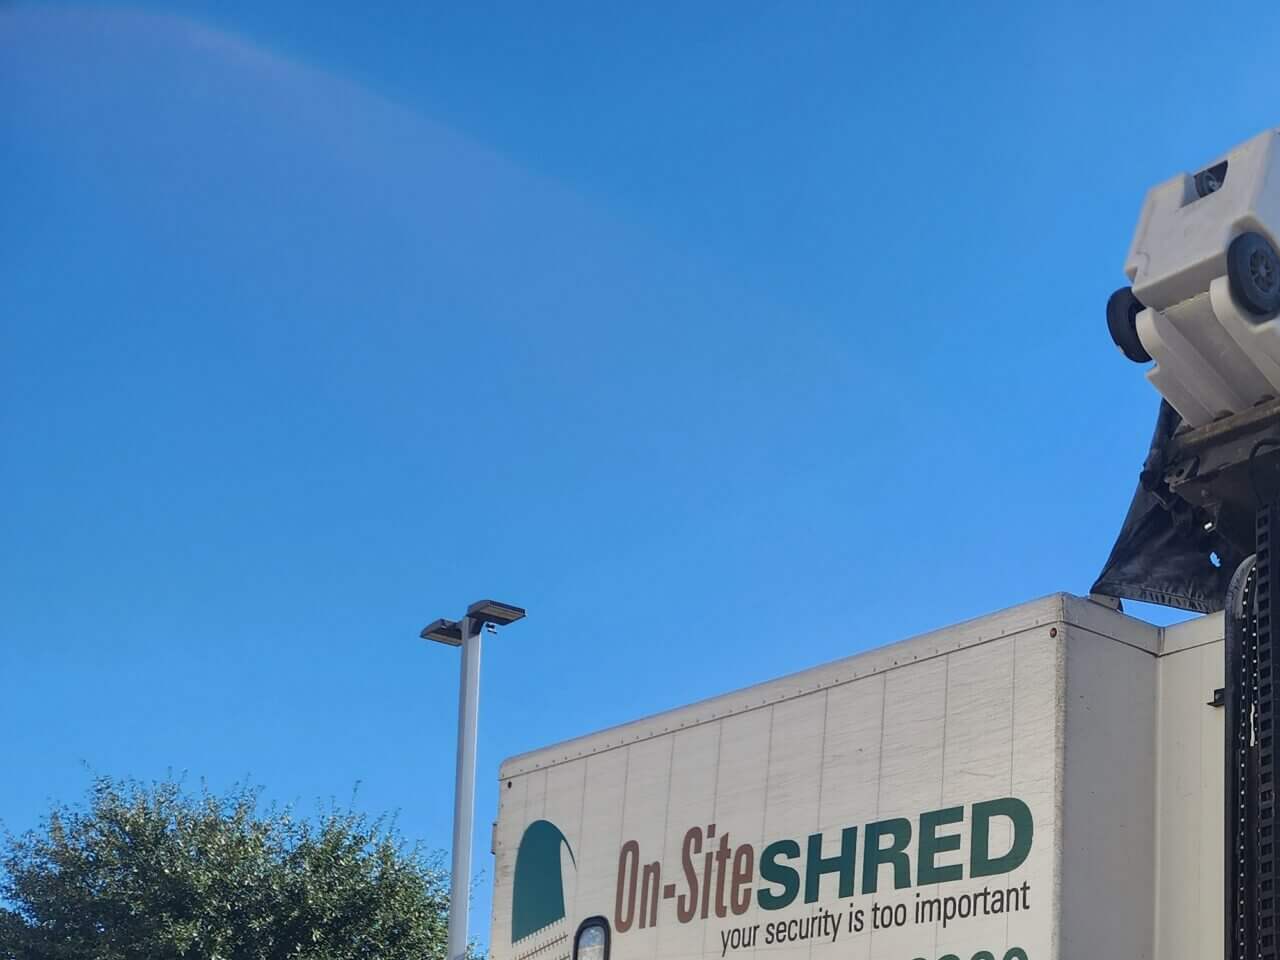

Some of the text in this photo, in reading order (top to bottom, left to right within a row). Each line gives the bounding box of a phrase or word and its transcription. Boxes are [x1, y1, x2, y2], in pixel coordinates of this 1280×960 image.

[720, 880, 1030, 956] your security is too important
